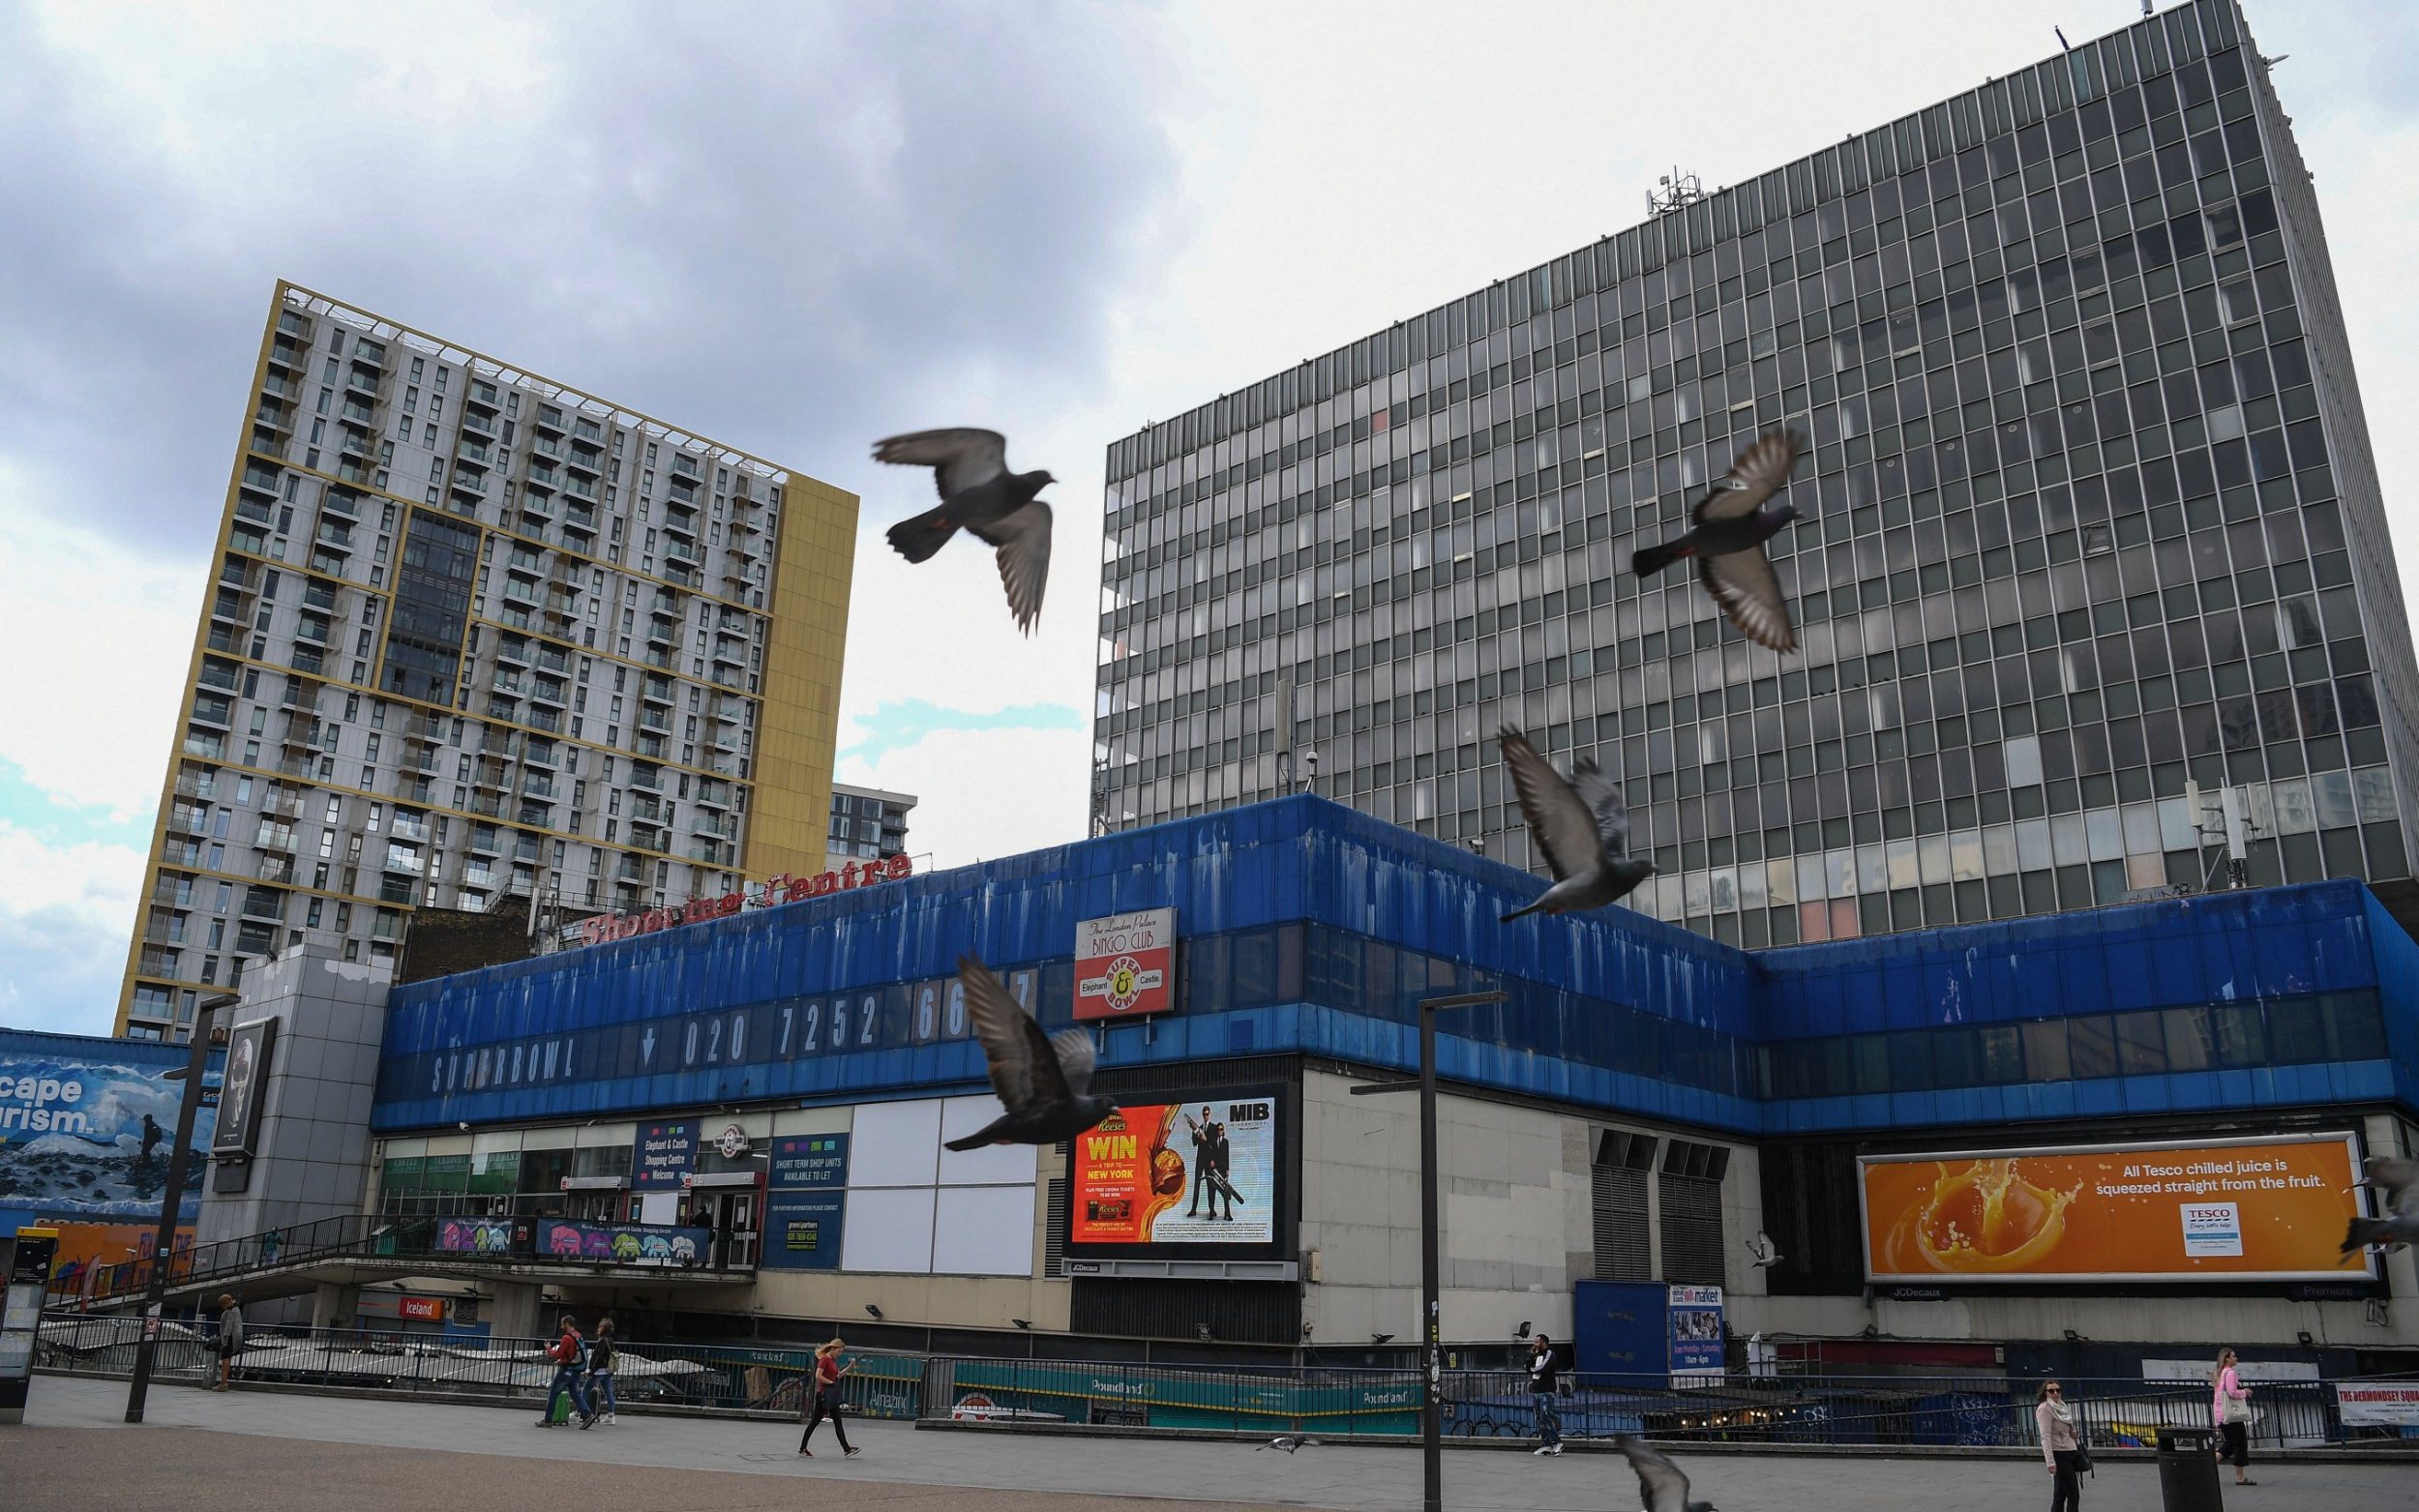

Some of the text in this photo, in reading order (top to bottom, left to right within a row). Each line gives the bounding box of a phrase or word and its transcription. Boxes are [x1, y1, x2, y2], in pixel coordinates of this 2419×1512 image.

[763, 853, 912, 907] Centre
[1089, 914, 1156, 935] The London Palace
[1092, 931, 1153, 956] BINGO CLUB
[1106, 958, 1141, 982] SUPER
[1082, 981, 1108, 993] Elephant
[1140, 975, 1159, 985] Castle
[1107, 989, 1140, 1007] BOWL
[432, 973, 1030, 1092] SUPERBOWL 020 7252 667
[1229, 1102, 1269, 1122] MIB
[644, 1137, 689, 1150] Elephant & Castle
[1088, 1135, 1137, 1161] WIN
[644, 1154, 685, 1167] Shopping Centre
[776, 1157, 842, 1170] SHORT TERM SHOP UNITS
[2123, 1159, 2287, 1177] All Tesco chilled juice is
[652, 1170, 675, 1179] Welcome
[784, 1171, 831, 1181] AVAILABLE TO LET
[1088, 1170, 1133, 1179] NEW YORK
[2096, 1174, 2326, 1197] squeezed straight from the fruit.
[2188, 1209, 2230, 1219] TESCO
[1695, 1288, 1718, 1303] market
[1894, 1288, 1941, 1297] JCDecaux
[406, 1301, 433, 1316] Iceland
[1092, 1379, 1143, 1395] Poundland
[2339, 1390, 2352, 1403] THE
[2354, 1390, 2400, 1402] BERMONDSEY
